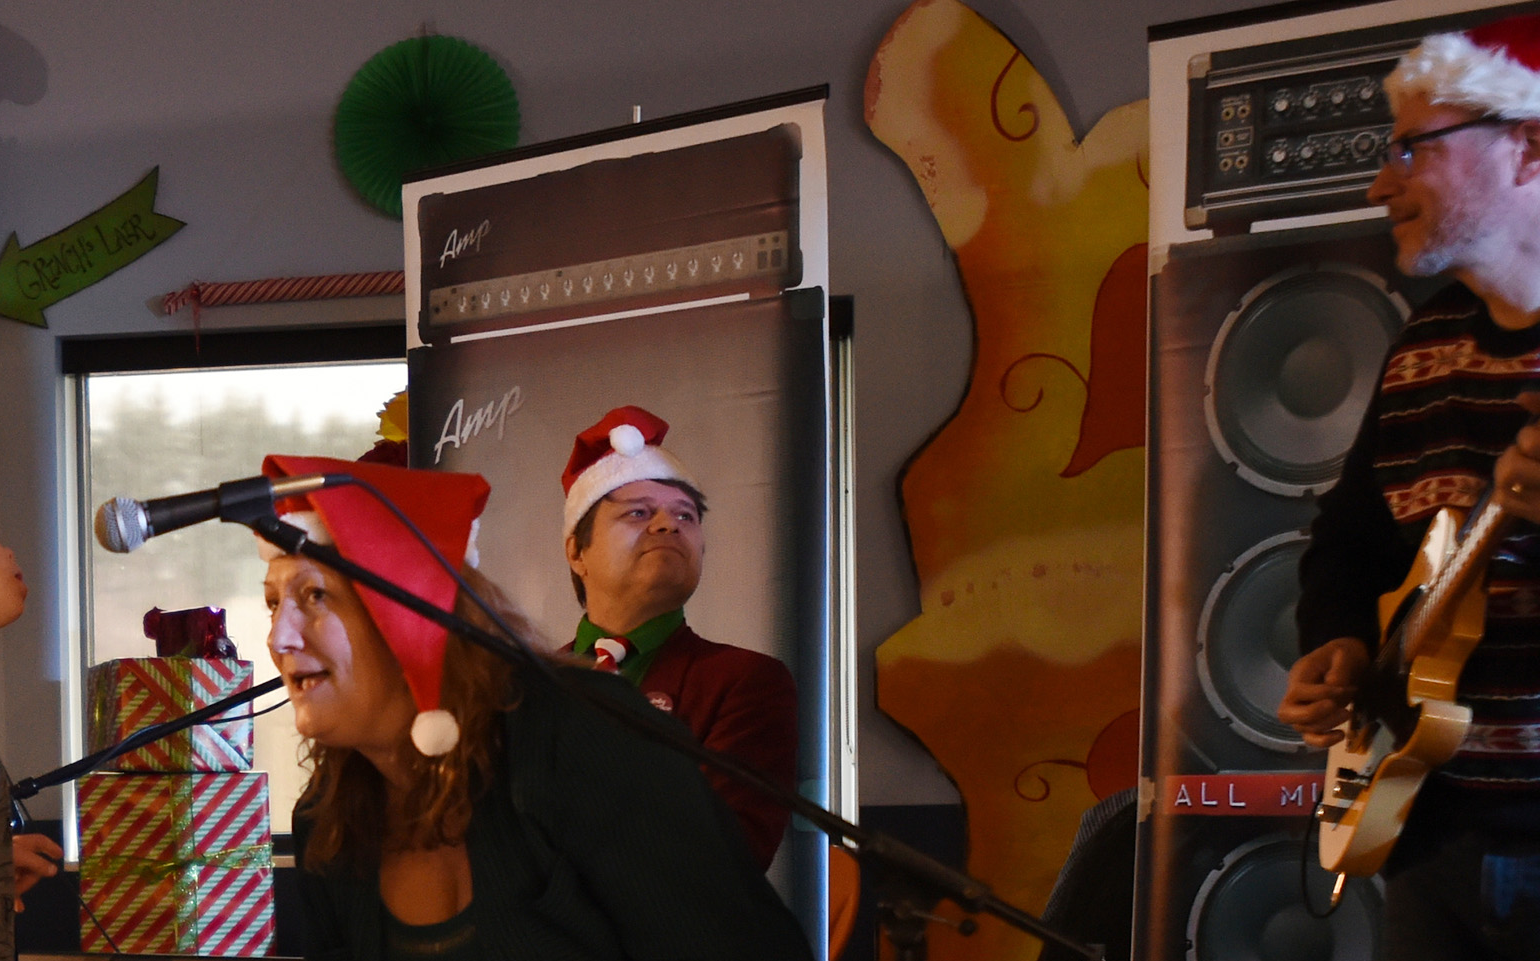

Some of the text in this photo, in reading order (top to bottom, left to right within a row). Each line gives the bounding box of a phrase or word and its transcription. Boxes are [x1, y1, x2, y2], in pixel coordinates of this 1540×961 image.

[439, 219, 491, 269] Amp
[433, 385, 524, 465] Amp
[1174, 782, 1247, 808] ALL
